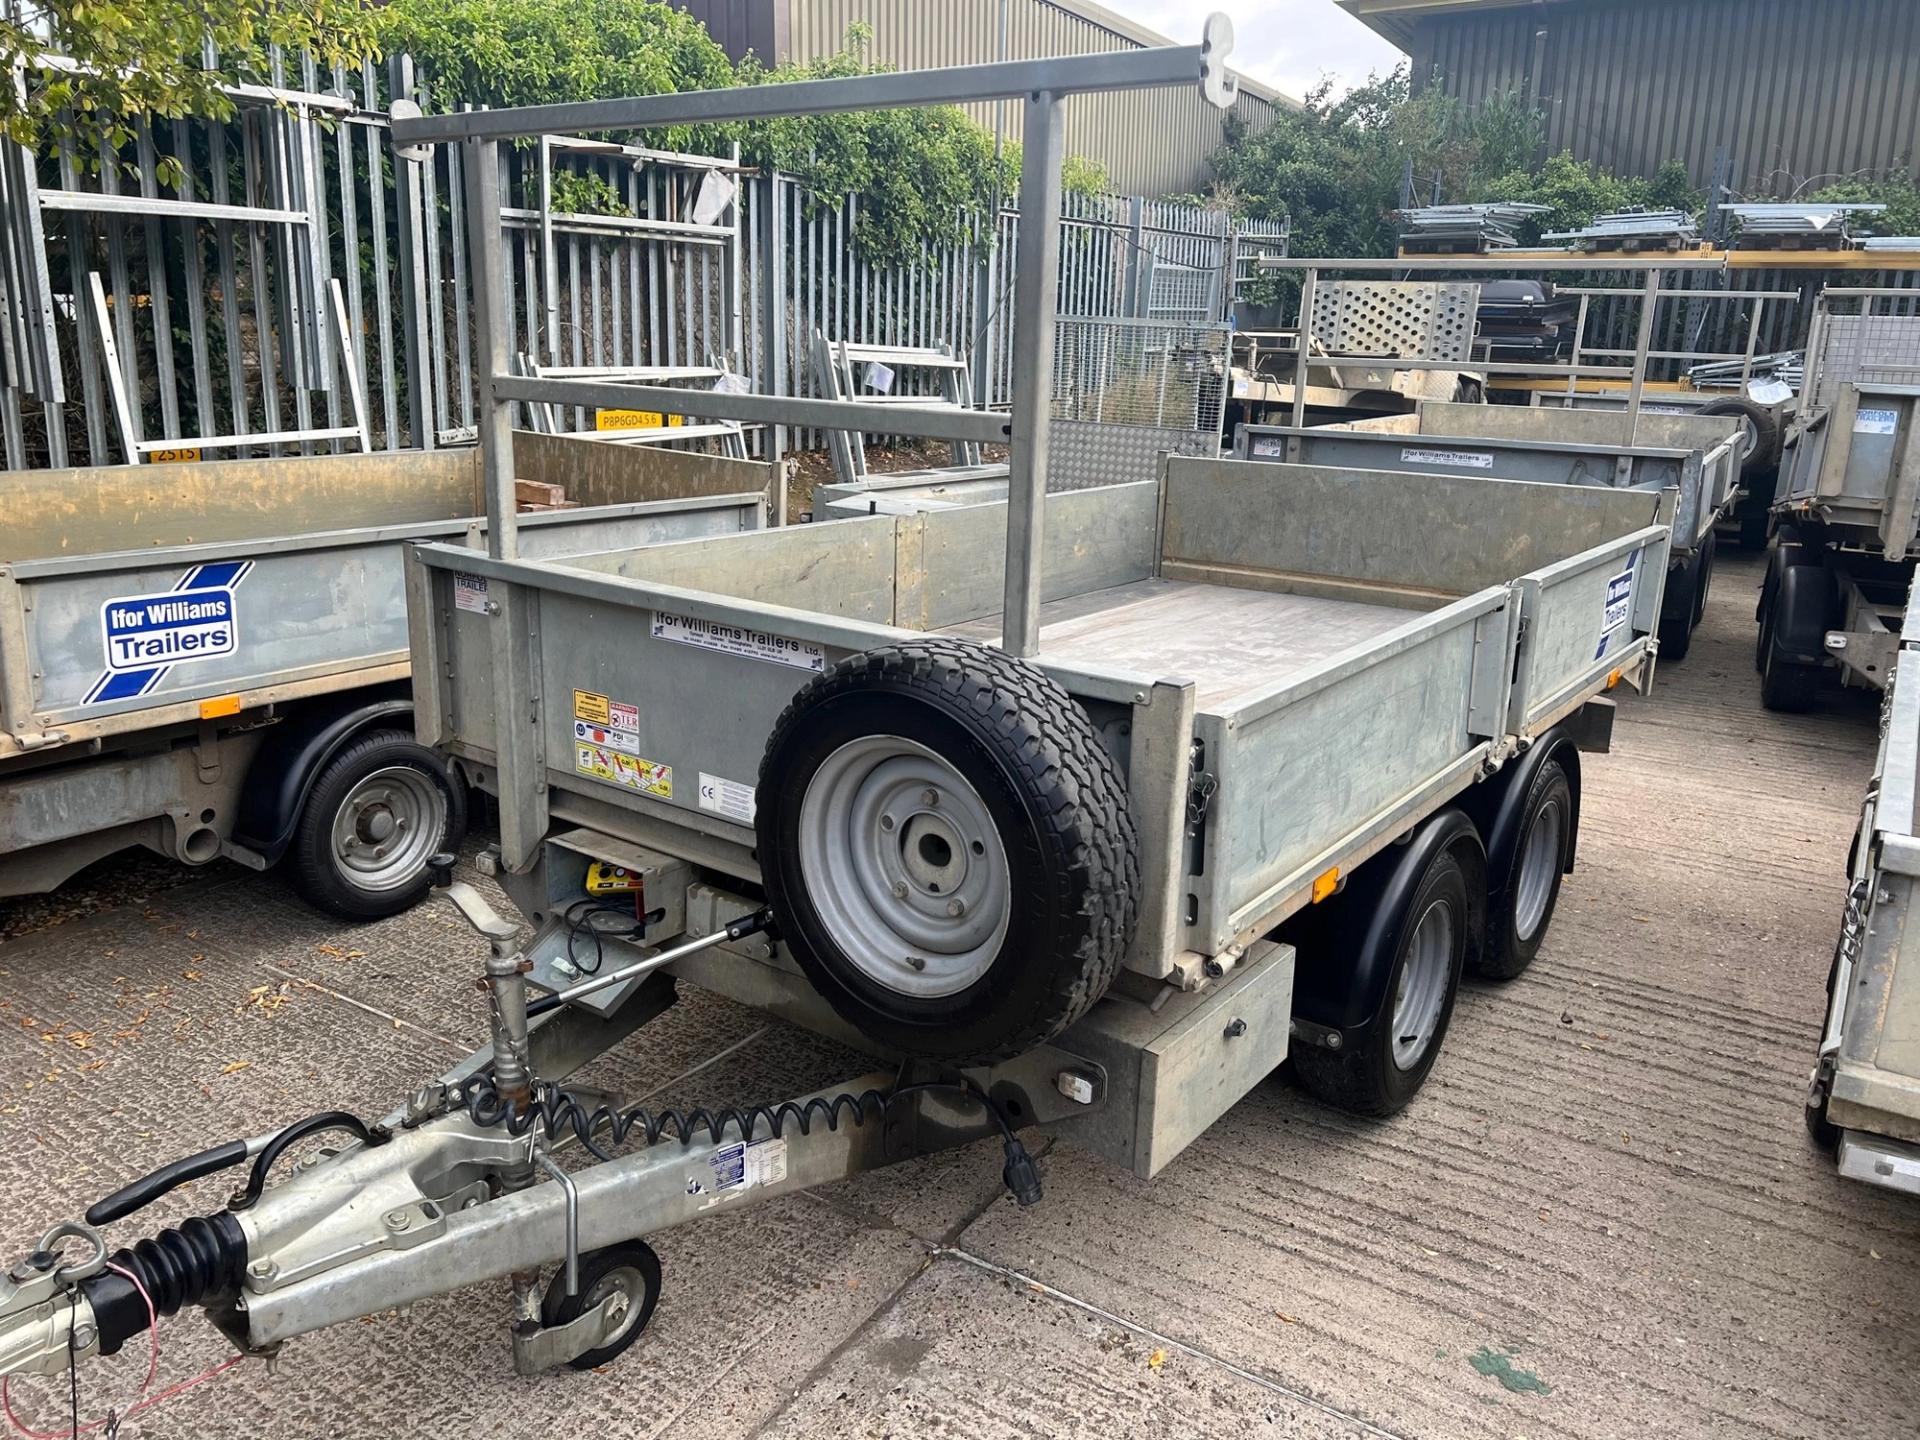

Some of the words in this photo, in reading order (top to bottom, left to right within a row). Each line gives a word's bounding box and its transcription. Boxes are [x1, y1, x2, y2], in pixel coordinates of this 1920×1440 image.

[1418, 451, 1451, 459] Williams
[1452, 453, 1480, 461] Trailers
[111, 609, 145, 629] Ifor
[147, 601, 227, 624] Williams
[115, 630, 227, 659] Trailers
[656, 611, 679, 627] Ifor
[680, 616, 742, 640] Williams
[744, 629, 799, 652] Trailers
[804, 646, 821, 657] Ltd.
[702, 785, 713, 800] CE
